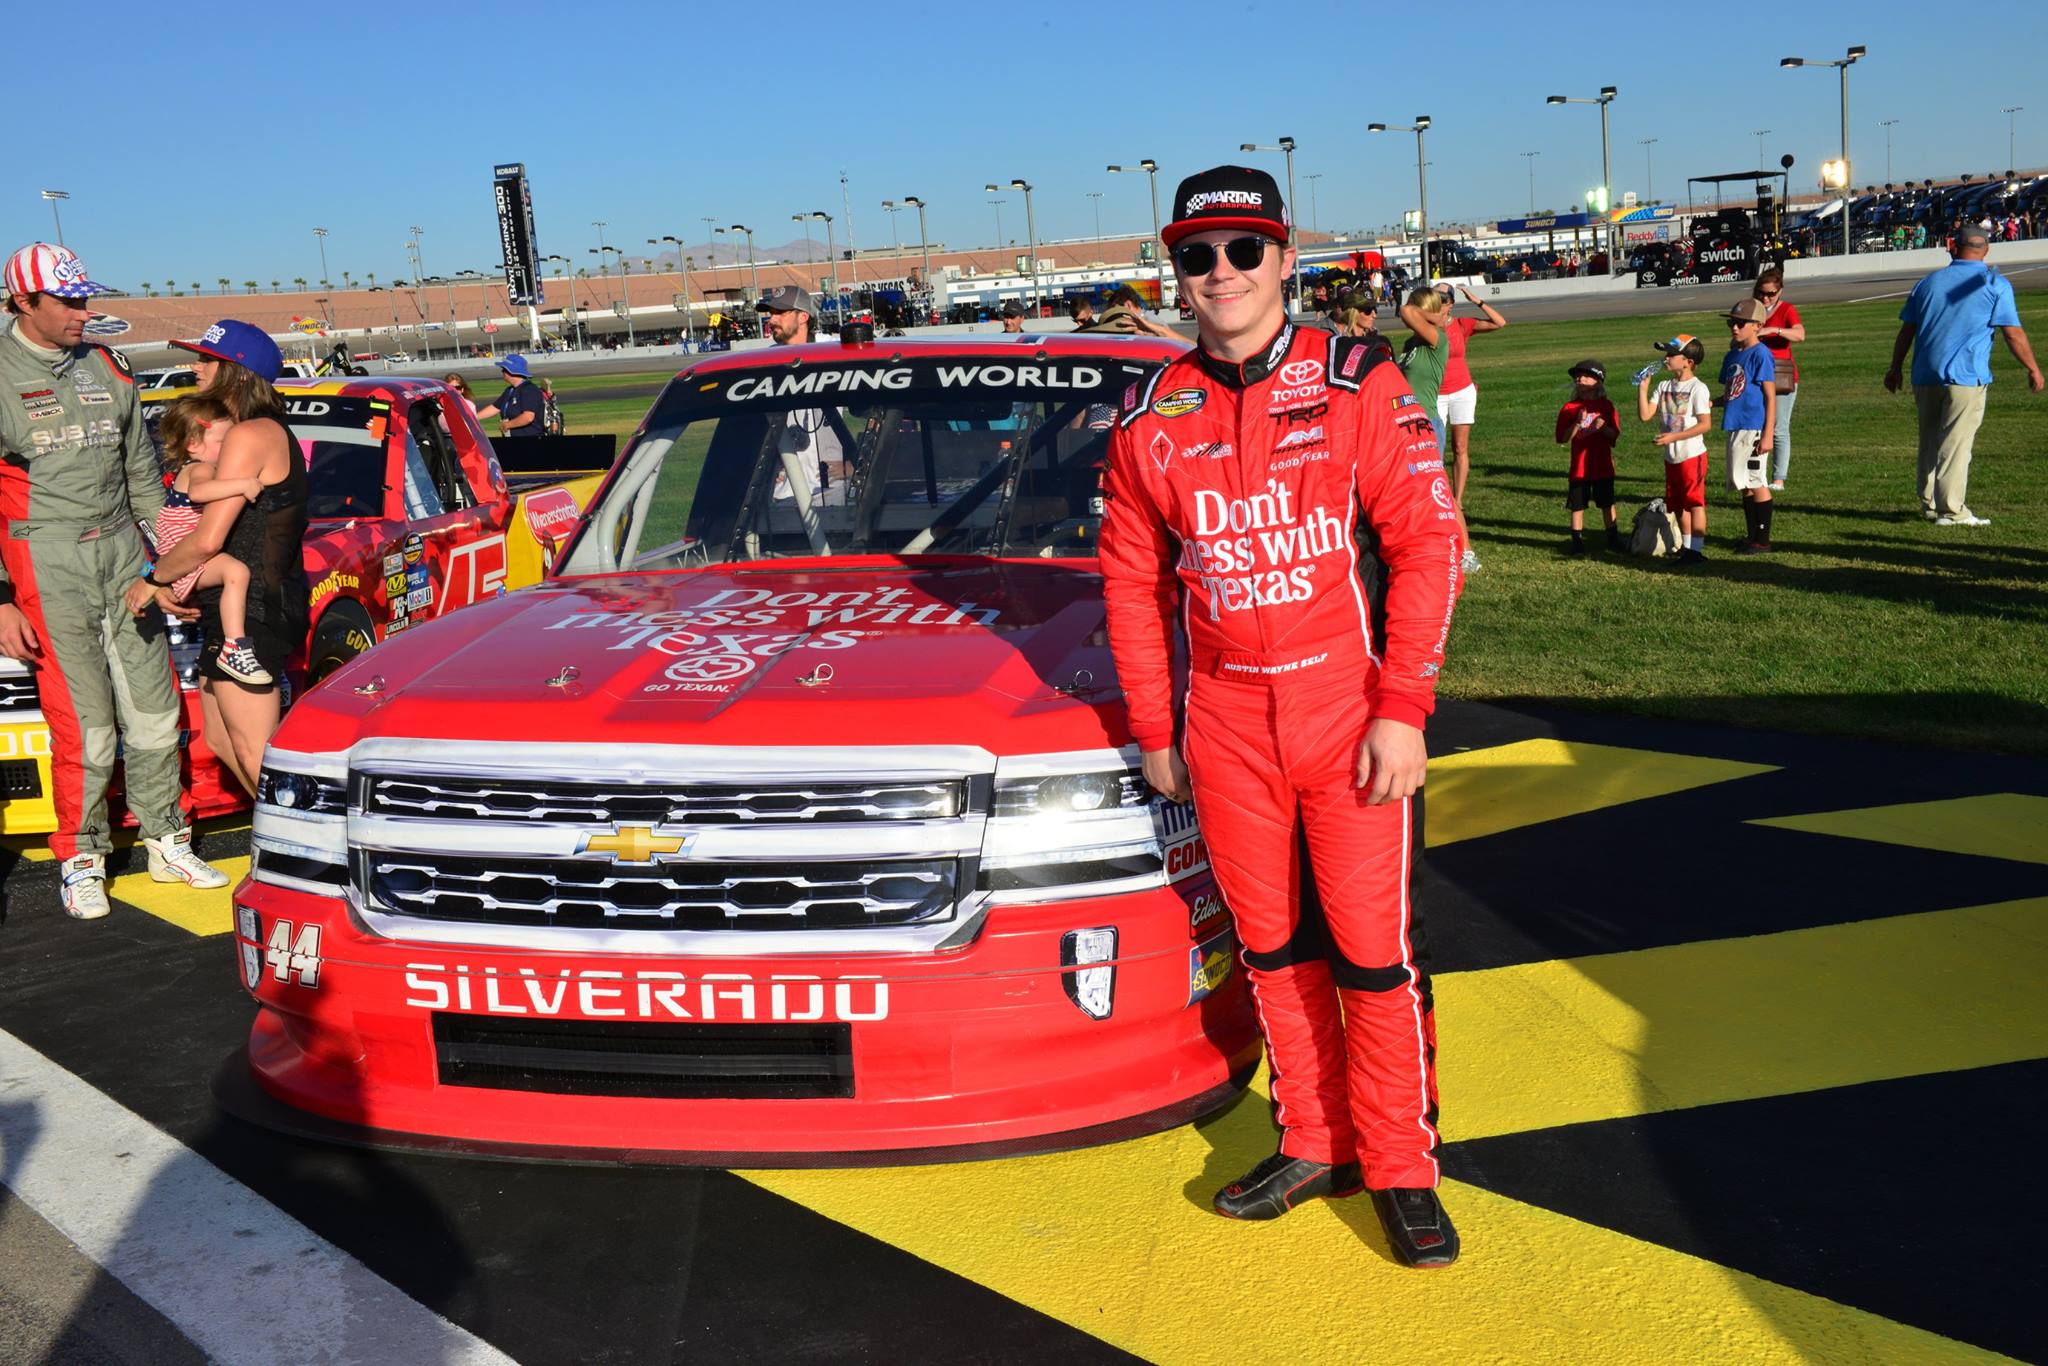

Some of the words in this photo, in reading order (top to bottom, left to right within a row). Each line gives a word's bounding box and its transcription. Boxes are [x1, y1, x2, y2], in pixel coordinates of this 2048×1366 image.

[496, 167, 519, 175] KOBALT
[495, 186, 506, 215] 300
[1525, 219, 1556, 228] SUNOCO
[501, 217, 513, 265] GAMING
[1700, 246, 1745, 262] switch
[1670, 275, 1700, 286] switch
[1712, 271, 1741, 283] switch
[294, 322, 326, 331] SUNOCO
[727, 368, 913, 402] CAMPING
[936, 366, 1102, 388] WORLD
[1271, 383, 1327, 402] TOYOTA
[1269, 402, 1329, 427] TRD
[1194, 478, 1297, 537] Don't
[1258, 505, 1346, 566] with
[692, 586, 912, 608] Don't
[544, 609, 785, 629] mess
[806, 602, 1000, 626] with
[1224, 663, 1259, 673] AUSTIN
[1262, 662, 1298, 674] WAYNE
[1300, 653, 1328, 668] SELF
[644, 684, 671, 692] GO
[264, 918, 323, 989] 44
[1196, 955, 1231, 992] SUNOCO
[404, 963, 889, 1022] SILVERADO
